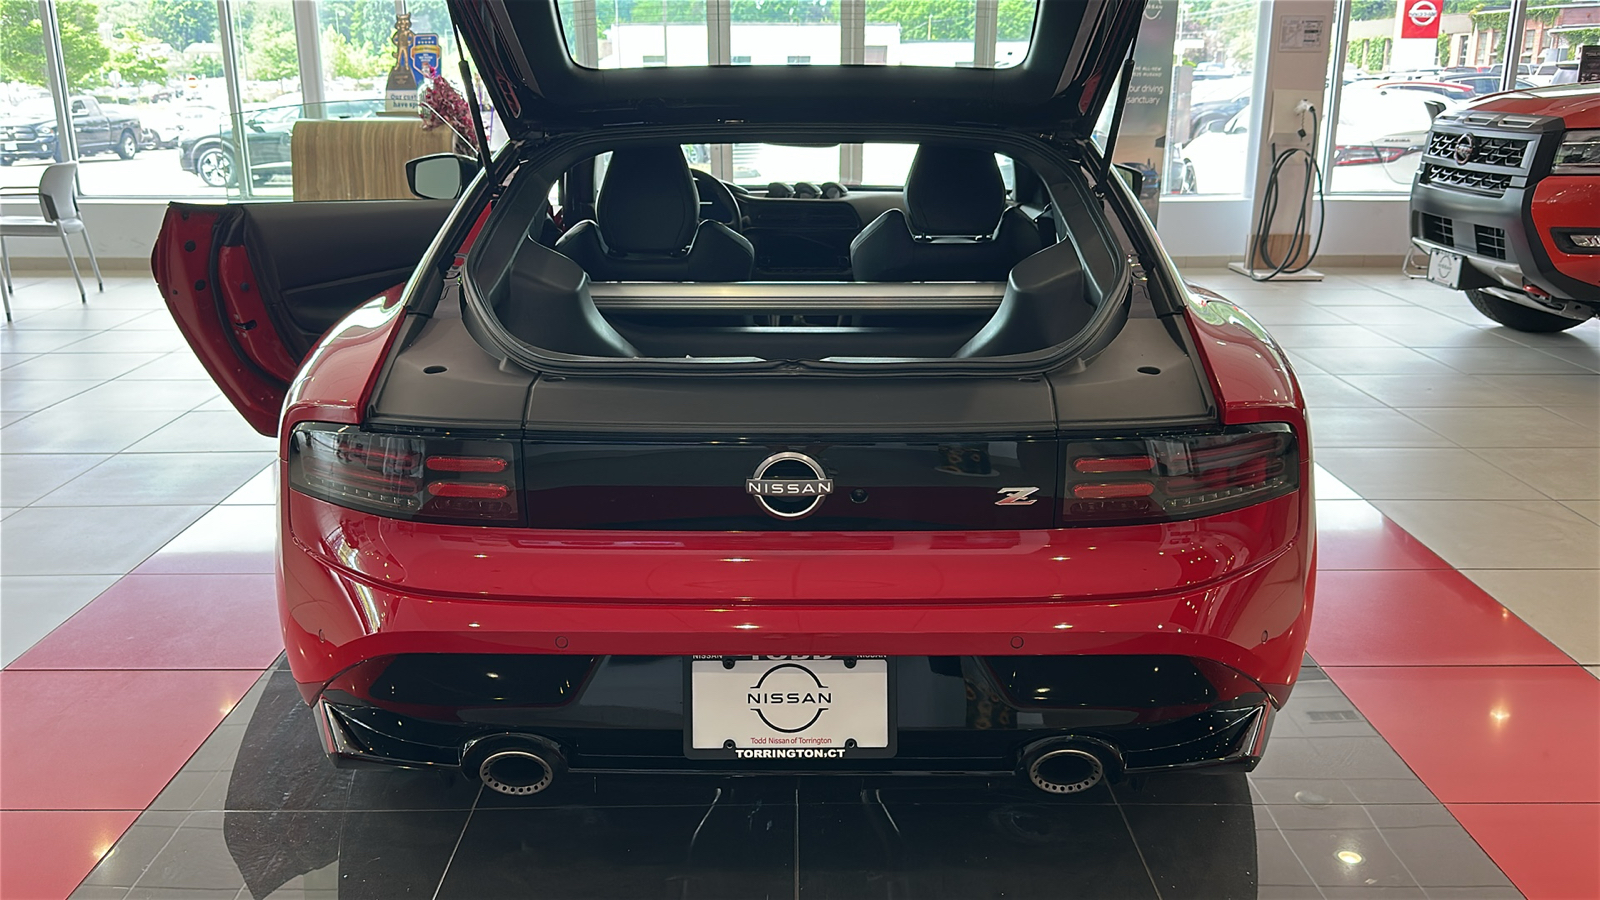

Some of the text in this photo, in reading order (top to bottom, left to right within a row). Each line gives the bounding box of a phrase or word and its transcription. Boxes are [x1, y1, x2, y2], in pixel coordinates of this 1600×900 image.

[1129, 84, 1164, 95] our driving
[1126, 95, 1161, 106] sanctuary
[748, 481, 832, 494] NISSAN
[994, 486, 1040, 506] Z
[747, 692, 832, 704] NISSAN
[750, 737, 767, 745] Todd
[798, 737, 832, 745] Torrington
